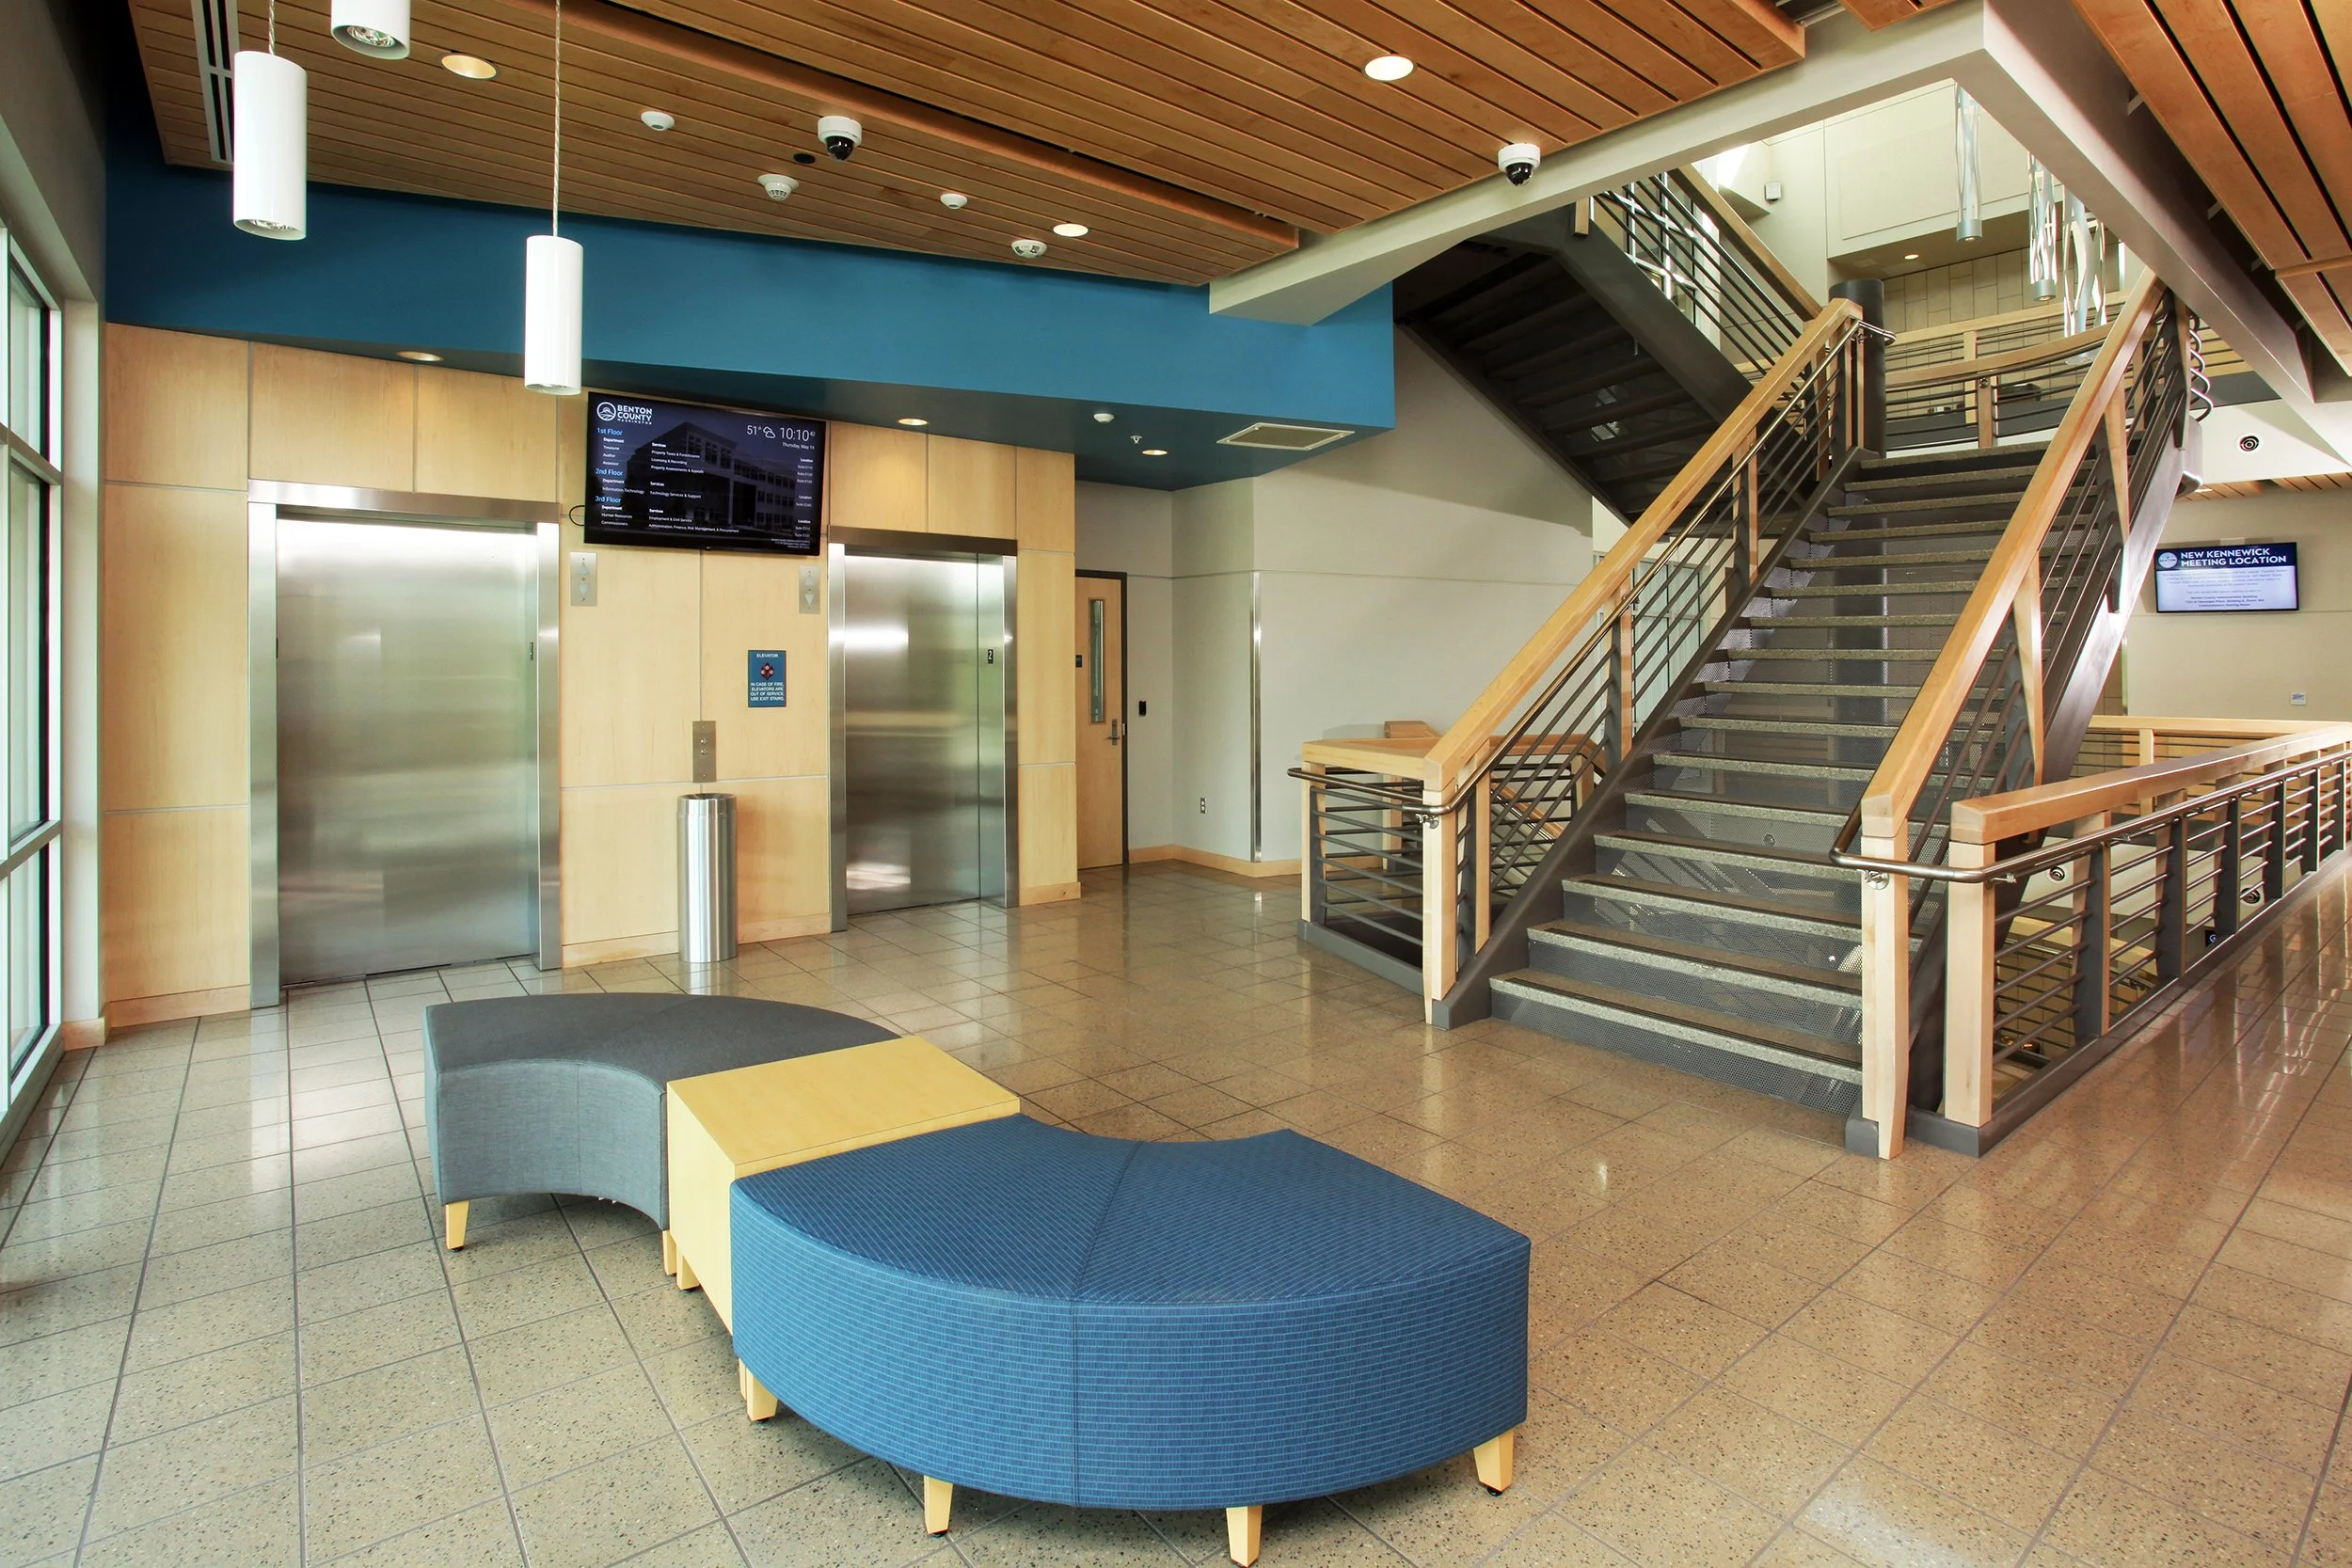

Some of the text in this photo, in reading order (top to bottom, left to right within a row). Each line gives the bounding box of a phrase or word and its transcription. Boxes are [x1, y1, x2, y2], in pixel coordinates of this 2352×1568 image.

[617, 404, 653, 415] BENTON
[617, 412, 652, 422] COUNTY
[780, 427, 810, 442] 10:10
[2181, 547, 2270, 561] NEW KENNEWICK
[2182, 555, 2287, 567] MEETING LOCATION
[989, 650, 993, 660] 2
